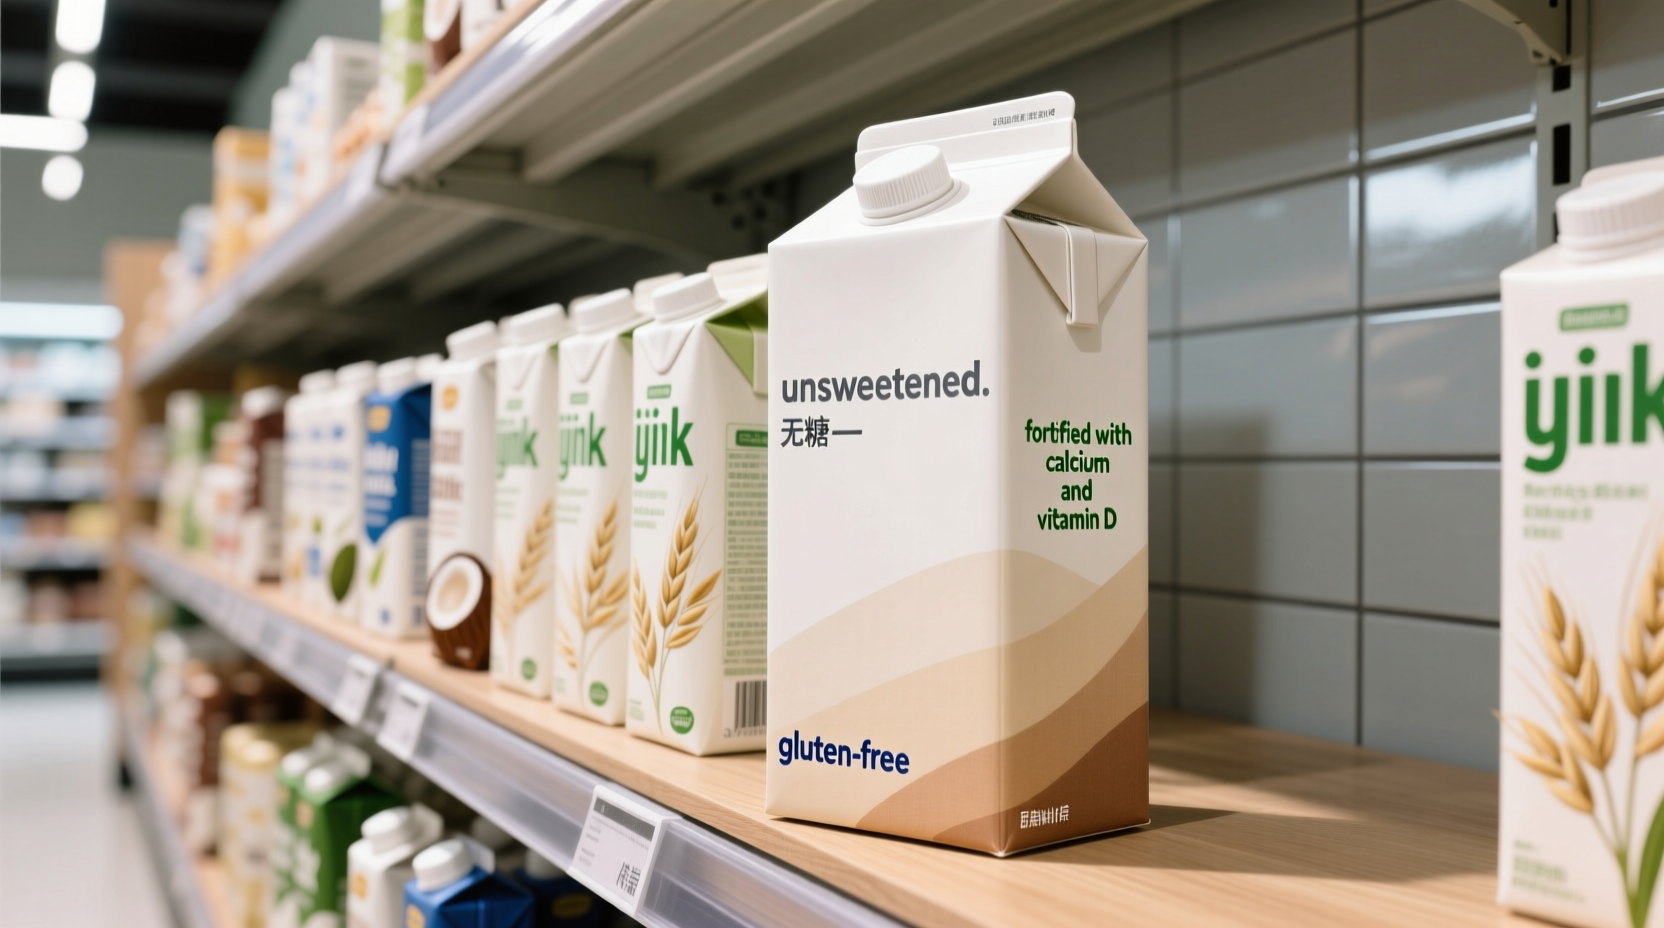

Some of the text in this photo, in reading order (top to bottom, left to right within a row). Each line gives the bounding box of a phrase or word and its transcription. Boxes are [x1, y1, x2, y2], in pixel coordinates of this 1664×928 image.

[781, 360, 989, 403] unsweetened.
[1095, 422, 1132, 445] with
[1046, 450, 1110, 473] calcium
[1061, 478, 1092, 501] and
[1037, 507, 1117, 530] vitamin D
[778, 730, 910, 774] gluten-free
